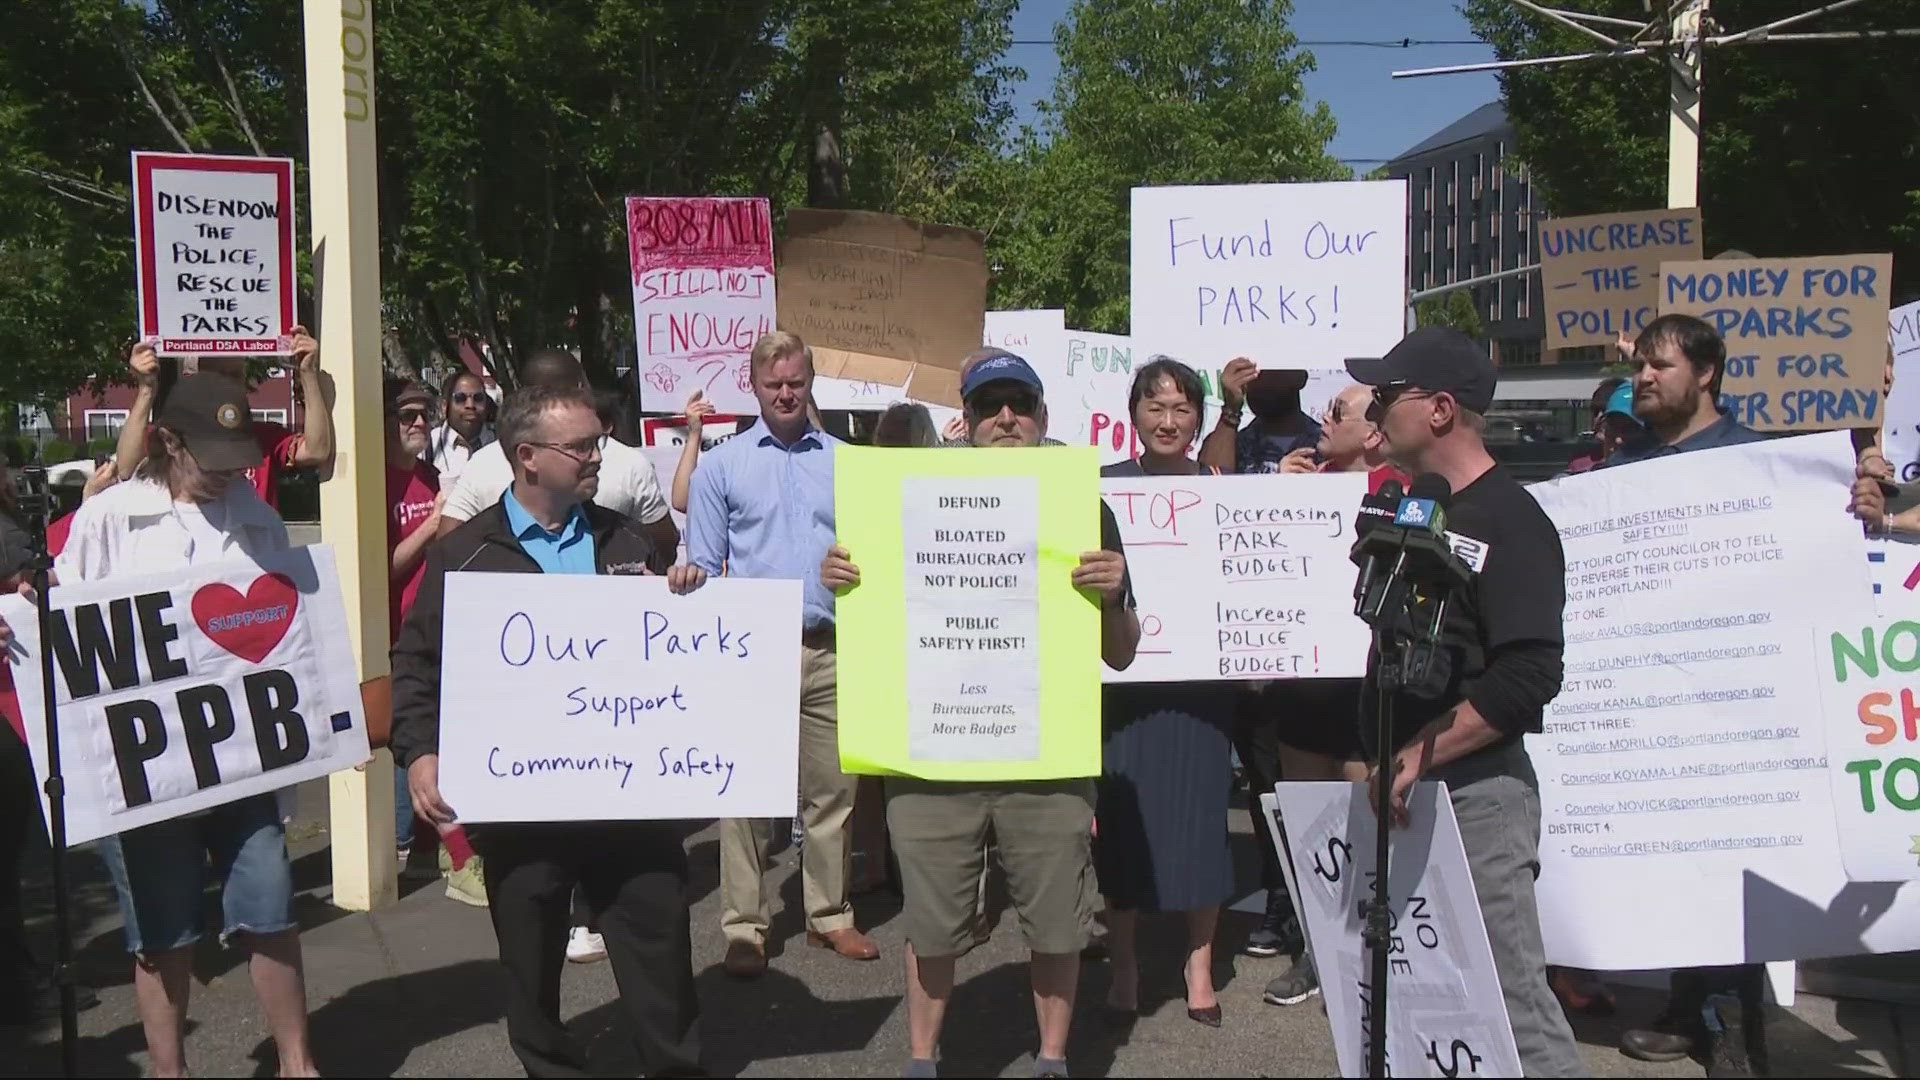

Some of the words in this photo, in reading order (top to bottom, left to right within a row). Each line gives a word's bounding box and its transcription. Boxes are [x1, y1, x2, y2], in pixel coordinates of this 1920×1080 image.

[157, 191, 279, 220] DISENDOW
[194, 223, 235, 240] THE
[635, 203, 700, 250] 308
[1542, 218, 1695, 258] UNCREASE
[1169, 217, 1273, 266] Fund
[1304, 221, 1378, 260] Our
[172, 242, 264, 273] POLICE,
[177, 272, 271, 292] RESCUE
[639, 271, 714, 303] STILL
[727, 271, 766, 298] NOT
[1581, 265, 1642, 293] THE
[1666, 268, 1789, 304] MONEY
[1803, 265, 1877, 299] FOR
[201, 298, 238, 312] THE
[181, 313, 270, 335] PARKS
[647, 312, 770, 356] ENOUGH
[1556, 307, 1659, 338] POLIC
[1701, 307, 1852, 339] PARKS
[165, 340, 214, 351] Portland
[216, 341, 240, 351] DSA
[243, 341, 275, 351] Labor
[1066, 338, 1132, 377] FUN
[1725, 355, 1761, 378] OT
[1776, 353, 1850, 378] FOR
[1780, 387, 1879, 426] SPRAY
[938, 496, 1001, 509] DEFUND
[1100, 490, 1201, 536] TOP
[1215, 502, 1343, 538] Decreasing
[1558, 518, 1614, 538] PRIORITIZE
[1617, 505, 1702, 527] INVESTMENTS
[1706, 503, 1719, 515] IN
[1723, 496, 1772, 513] PUBLIC
[935, 529, 1006, 542] BLOATED
[1219, 531, 1289, 553] PARK
[916, 552, 1026, 566] BUREAUCRACY
[1583, 555, 1613, 568] YOUR
[1615, 550, 1640, 564] CITY
[1642, 541, 1720, 560] COUNCILOR
[1724, 538, 1742, 550] TO
[1746, 533, 1777, 547] TELL
[1222, 556, 1312, 577] BUDGET
[1581, 567, 1630, 585] REVERSE
[1634, 562, 1669, 576] THEIR
[1673, 557, 1709, 572] CUTS
[1713, 555, 1730, 567] TO
[1734, 548, 1784, 564] POLICE
[924, 575, 956, 588] NOT
[960, 575, 1017, 588] POLICE!
[1586, 588, 1596, 599] IN
[207, 604, 289, 633] SUPPORT
[945, 617, 999, 630] PUBLIC
[1217, 601, 1306, 624] Increase
[50, 590, 188, 701] WE
[500, 612, 608, 666] Our
[643, 611, 752, 661] Parks
[919, 637, 975, 650] SAFETY
[978, 637, 1026, 650] FIRST!
[1218, 629, 1292, 652] POLICE
[960, 683, 988, 695] Less
[566, 685, 687, 728] Support
[932, 702, 1016, 716] Bureaucrats,
[1551, 700, 1600, 715] Councilor
[932, 722, 966, 735] More
[969, 722, 1017, 737] Badges
[1543, 721, 1586, 734] ISTRICT
[488, 747, 633, 788] Community
[658, 747, 734, 795] Safety
[1613, 757, 1828, 779] KOYAMA-LANE@portlandoregon.g
[1547, 823, 1600, 834] DISTRICT
[1407, 896, 1439, 949] NO
